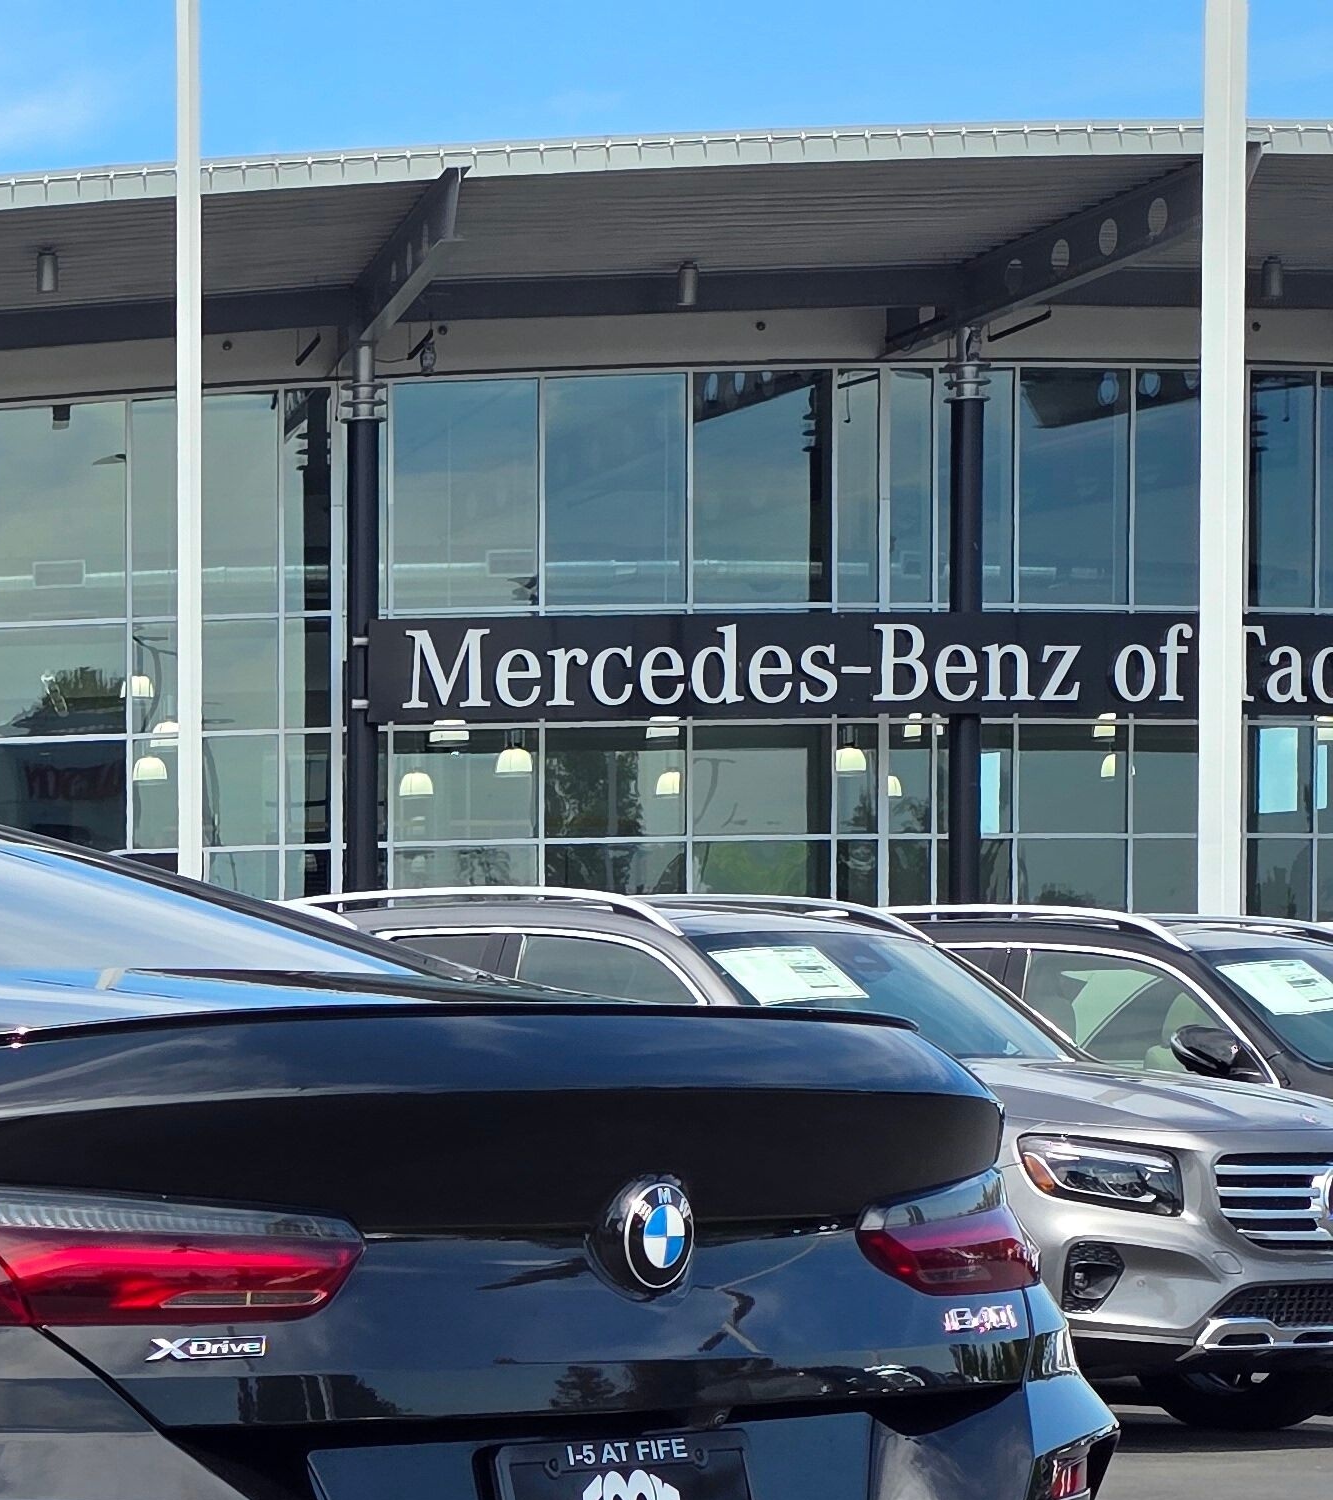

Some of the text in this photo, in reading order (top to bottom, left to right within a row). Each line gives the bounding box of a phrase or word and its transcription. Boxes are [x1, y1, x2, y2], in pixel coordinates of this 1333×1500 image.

[402, 624, 1082, 709] Mercedes-Benz
[1113, 623, 1193, 702] of
[567, 1438, 688, 1466] I-5 AT FIFE
